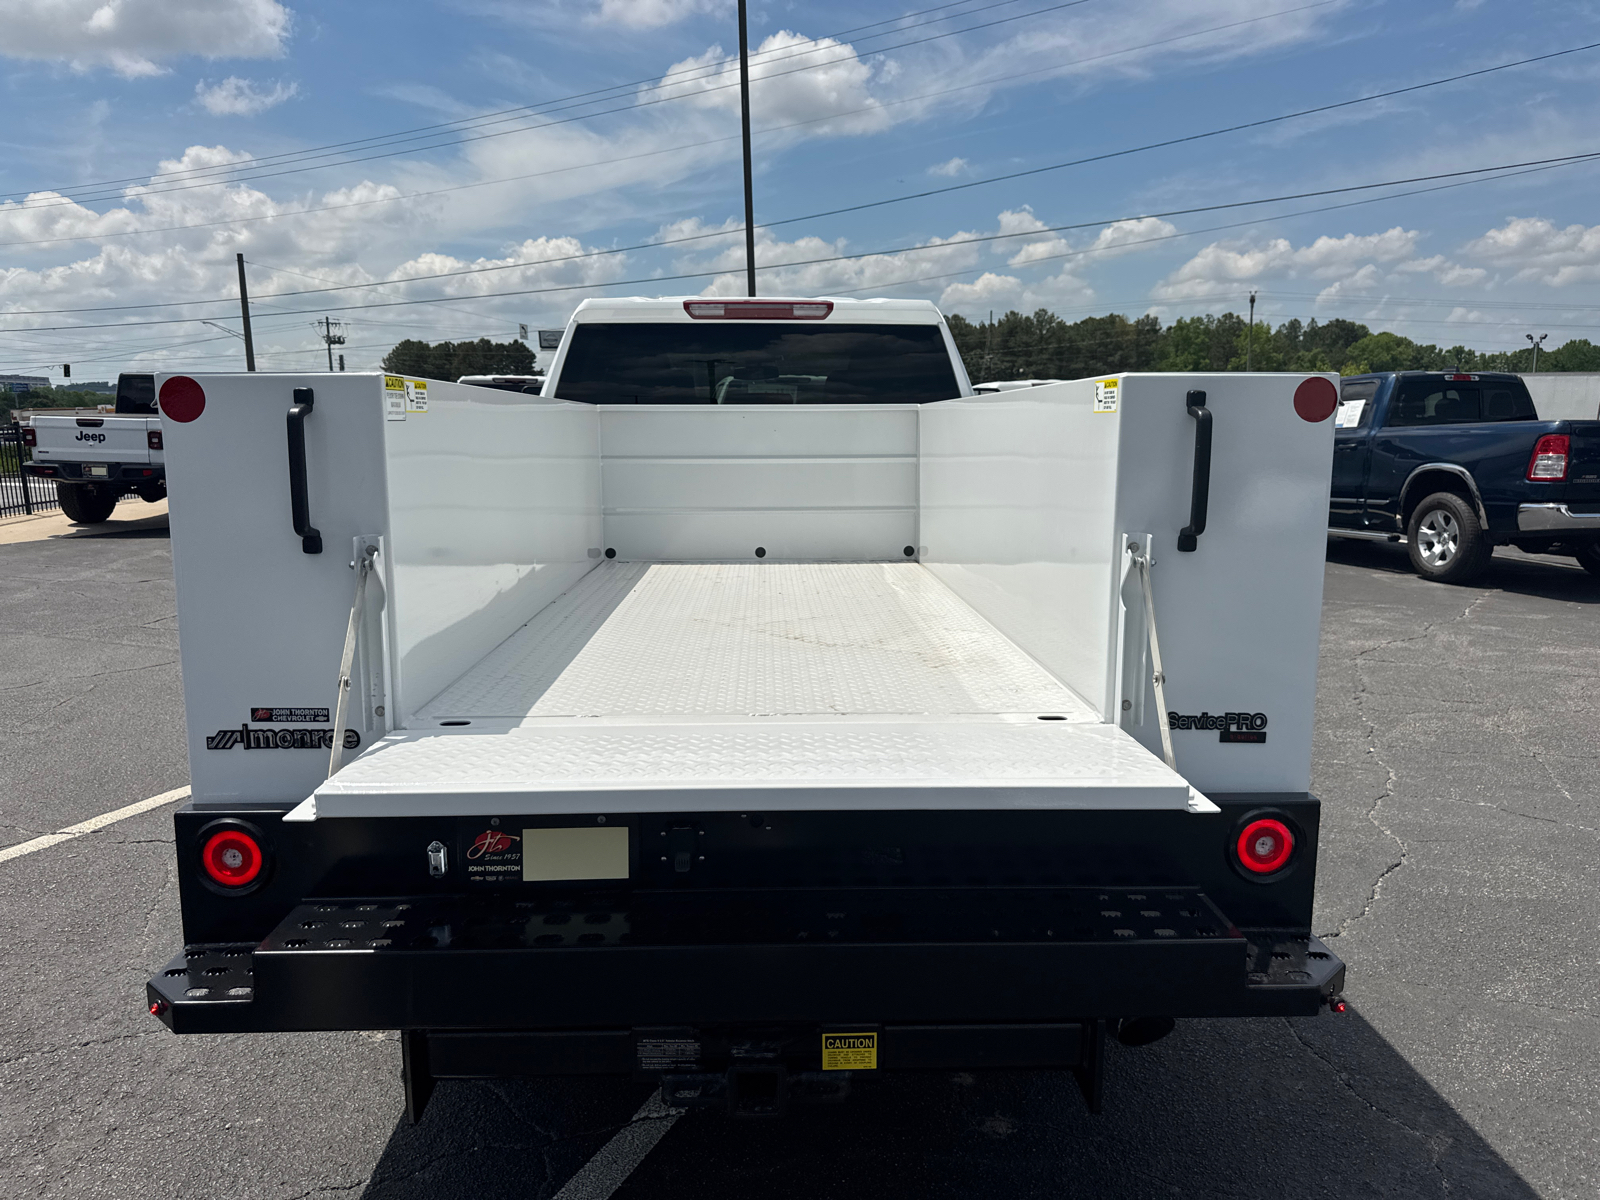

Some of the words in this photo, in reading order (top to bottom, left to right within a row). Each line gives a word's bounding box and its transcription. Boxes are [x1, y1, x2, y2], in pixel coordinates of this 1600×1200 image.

[75, 431, 106, 443] Jeep
[292, 708, 328, 716] THORNTON
[1168, 711, 1268, 731] ServicePRO
[826, 1038, 873, 1048] CAUTION
